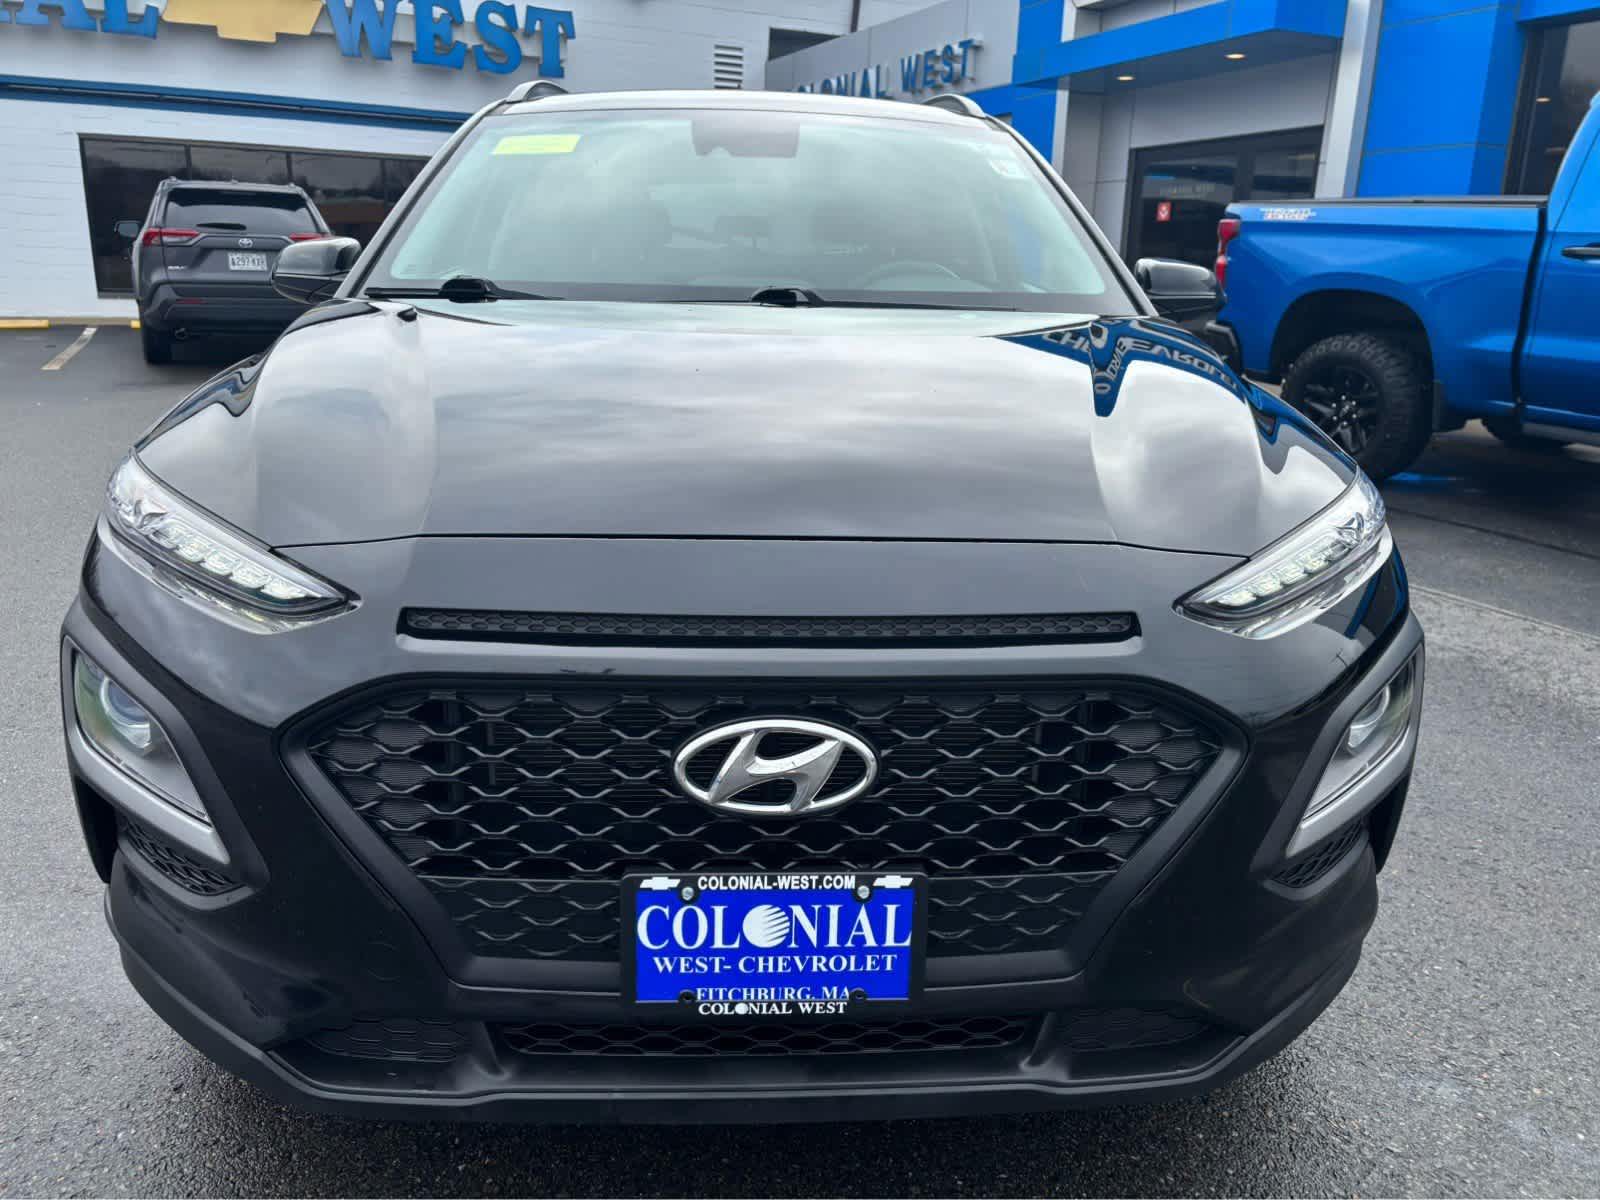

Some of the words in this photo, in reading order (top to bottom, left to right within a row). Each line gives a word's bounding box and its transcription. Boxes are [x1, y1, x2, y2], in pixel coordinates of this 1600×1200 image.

[325, 0, 576, 78] WEST
[900, 39, 975, 93] WEST
[697, 875, 856, 891] COLONIAL-WEST.COM
[637, 904, 912, 950] COLONIAL
[738, 954, 897, 973] CHEVROLET
[821, 986, 850, 1001] MA
[698, 1002, 793, 1015] COLONIAL
[797, 1002, 848, 1014] WEST
